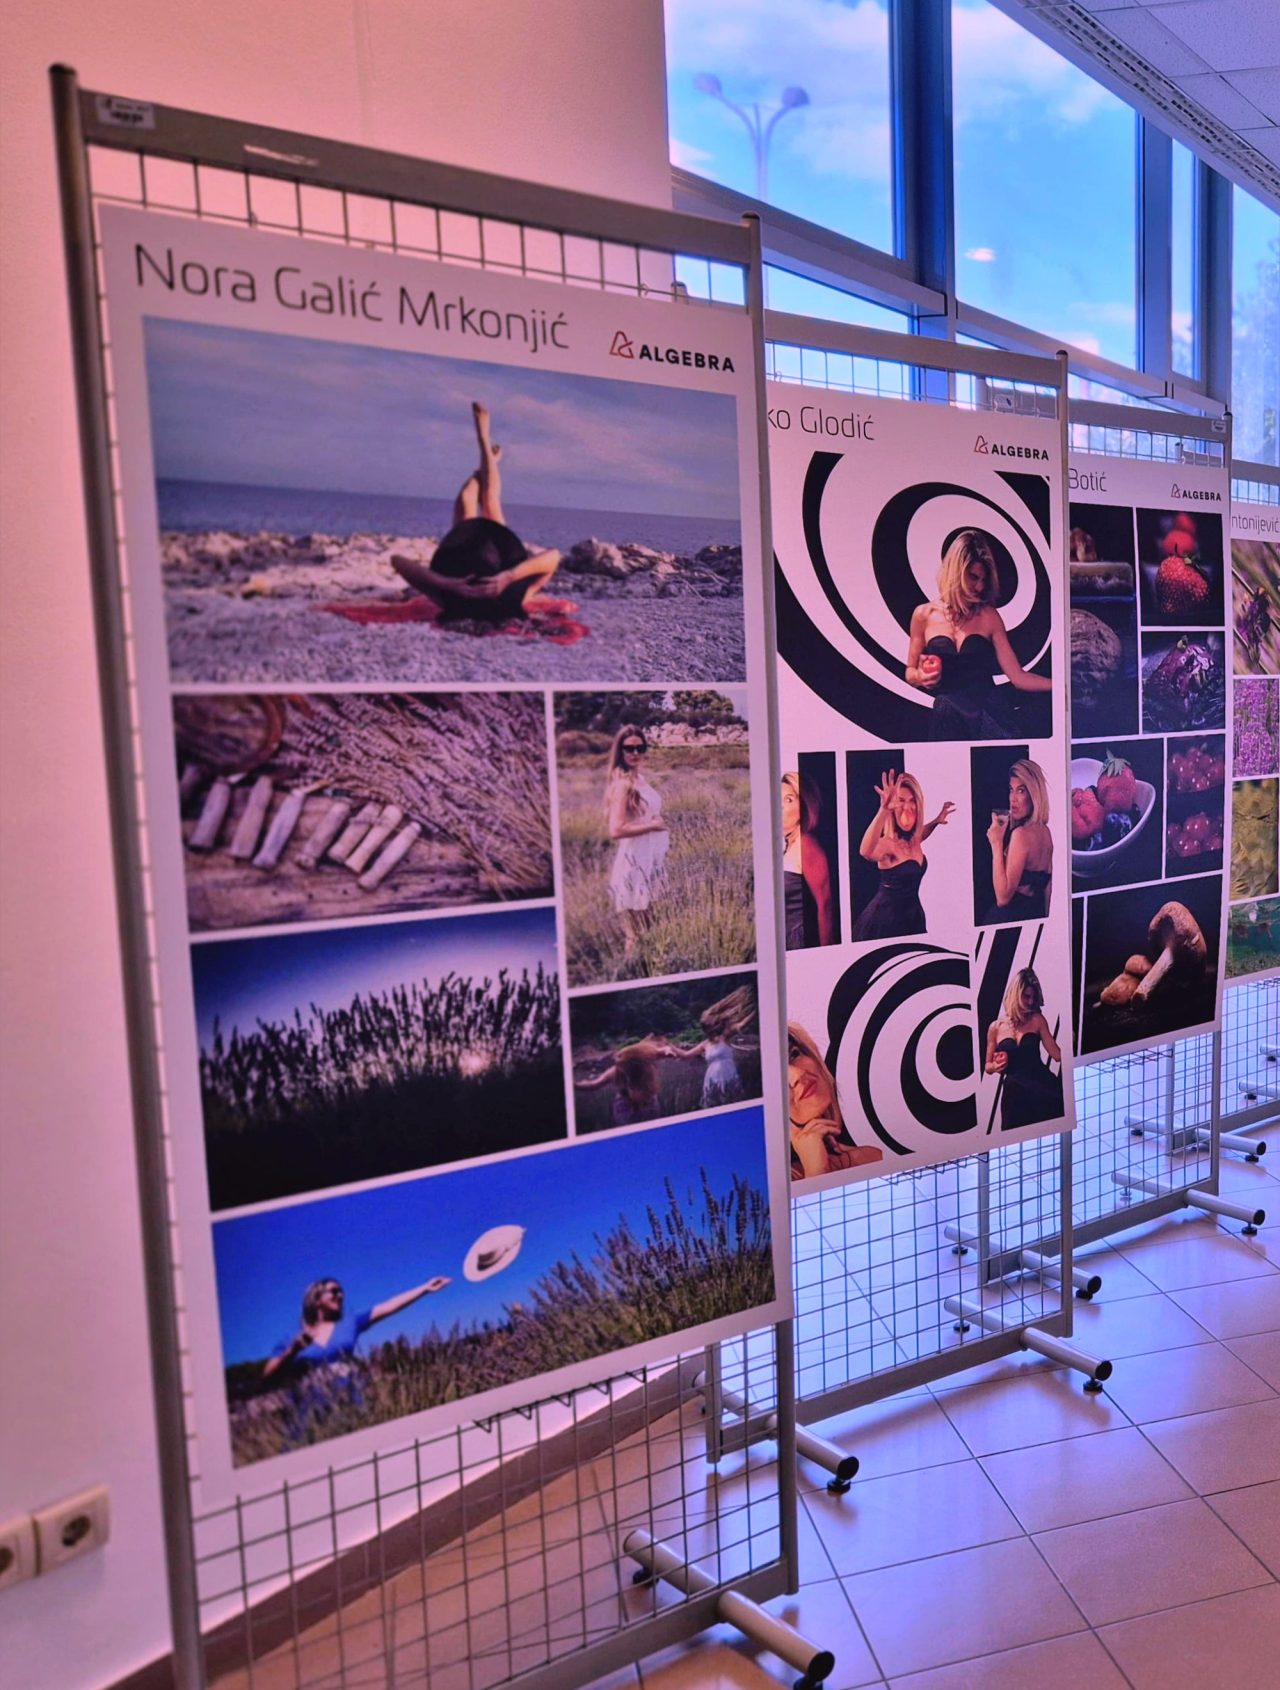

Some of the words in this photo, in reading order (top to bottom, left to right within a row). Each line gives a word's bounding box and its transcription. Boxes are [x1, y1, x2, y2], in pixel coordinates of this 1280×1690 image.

[135, 243, 257, 302] Nora
[274, 266, 383, 322] Galić
[399, 286, 570, 353] Mrkonjić
[639, 345, 736, 373] ALGEBRA
[800, 406, 875, 441] Glodić
[991, 444, 1050, 461] ALGEBRA
[1068, 467, 1107, 492] Botić
[1182, 489, 1222, 502] ALGEBRA
[1231, 514, 1280, 535] ntonijević
